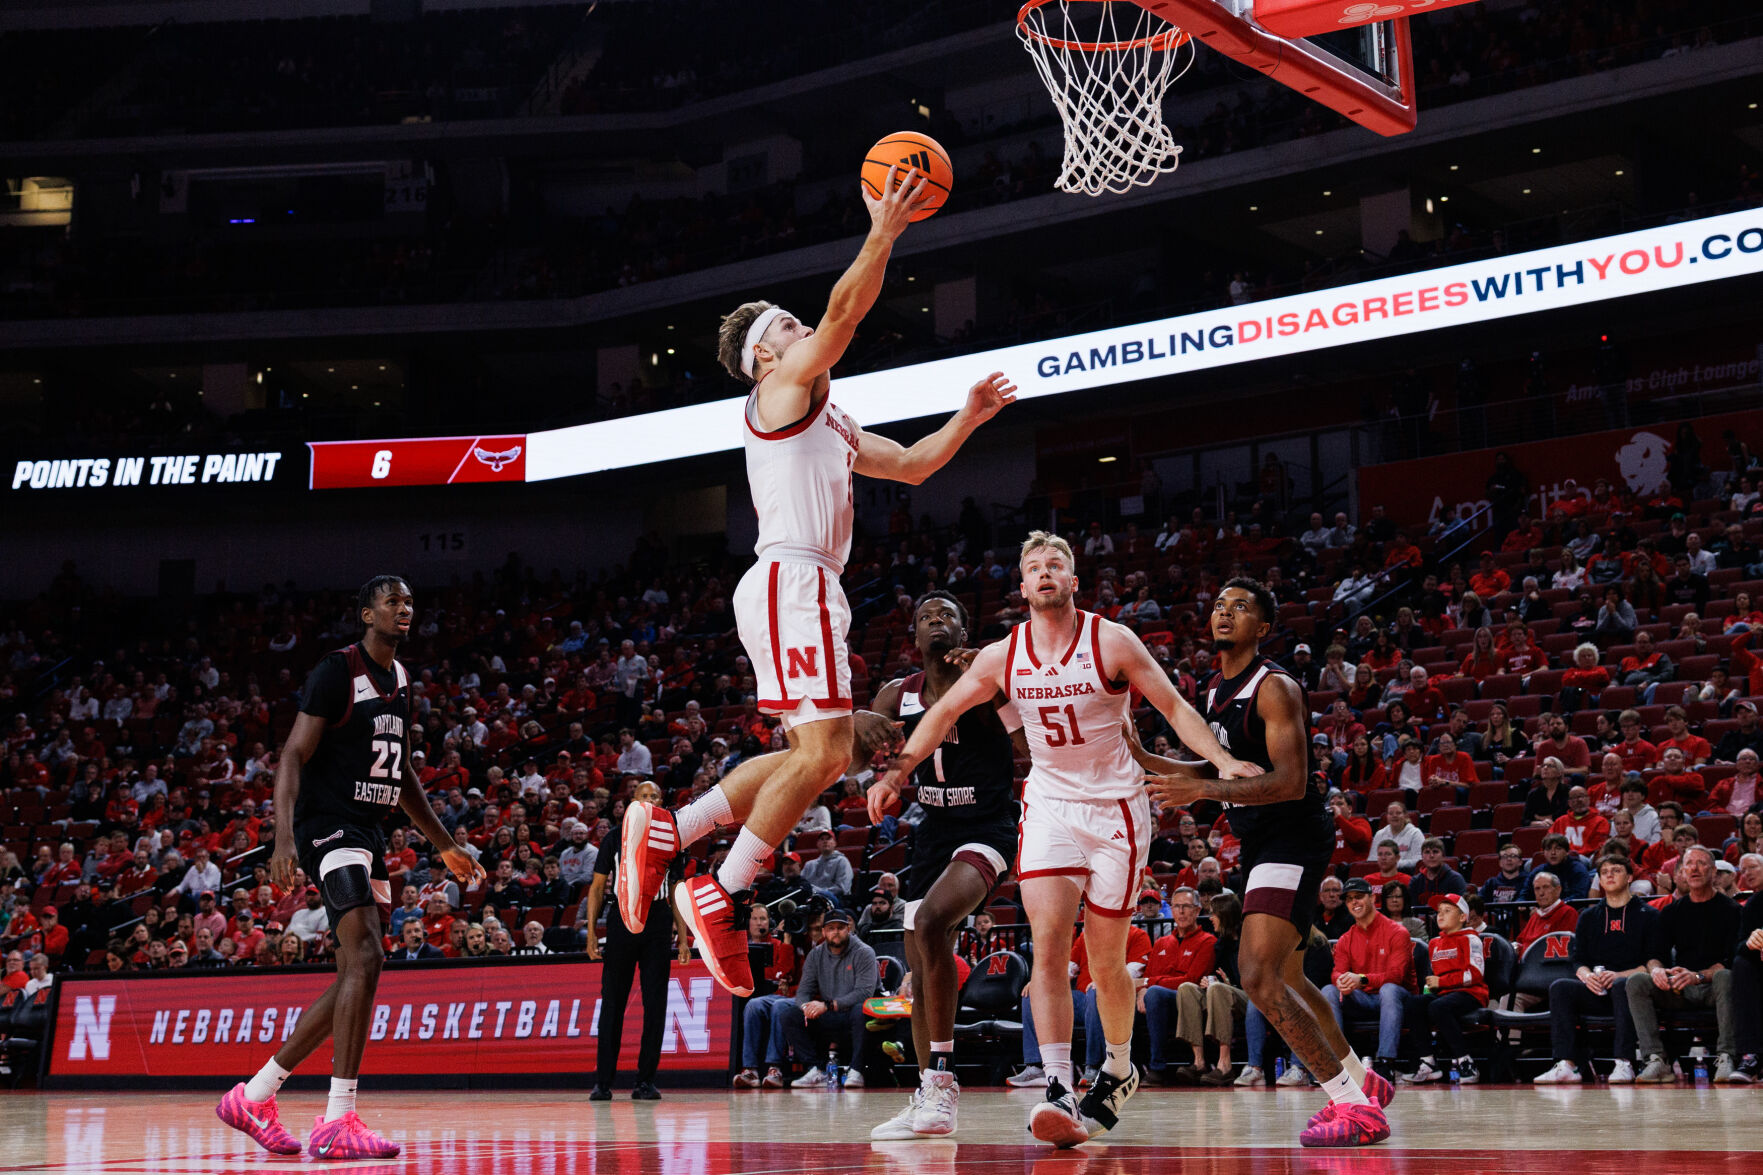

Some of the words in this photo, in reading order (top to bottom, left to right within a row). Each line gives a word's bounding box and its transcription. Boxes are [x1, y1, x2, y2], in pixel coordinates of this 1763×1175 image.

[12, 459, 111, 489] POINTS
[113, 457, 145, 486] IN
[150, 455, 200, 485] THE
[201, 452, 282, 483] PAINT
[371, 449, 393, 479] 6
[419, 533, 465, 550] 115
[786, 646, 819, 679] N
[1016, 682, 1096, 700] NEBRASKA
[373, 714, 404, 738] MARYLAND
[1038, 704, 1086, 748] 51
[369, 740, 402, 780] 22
[933, 748, 946, 783] 1
[354, 781, 393, 806] EASTERN
[946, 786, 977, 807] SHORE
[1565, 825, 1586, 847] N
[1610, 919, 1622, 931] N
[1543, 936, 1571, 958] N
[986, 955, 1010, 975] N
[68, 995, 117, 1061] N
[150, 1007, 302, 1044] NEBRASK
[369, 998, 603, 1041] BASKETBALL
[660, 976, 714, 1053] N
